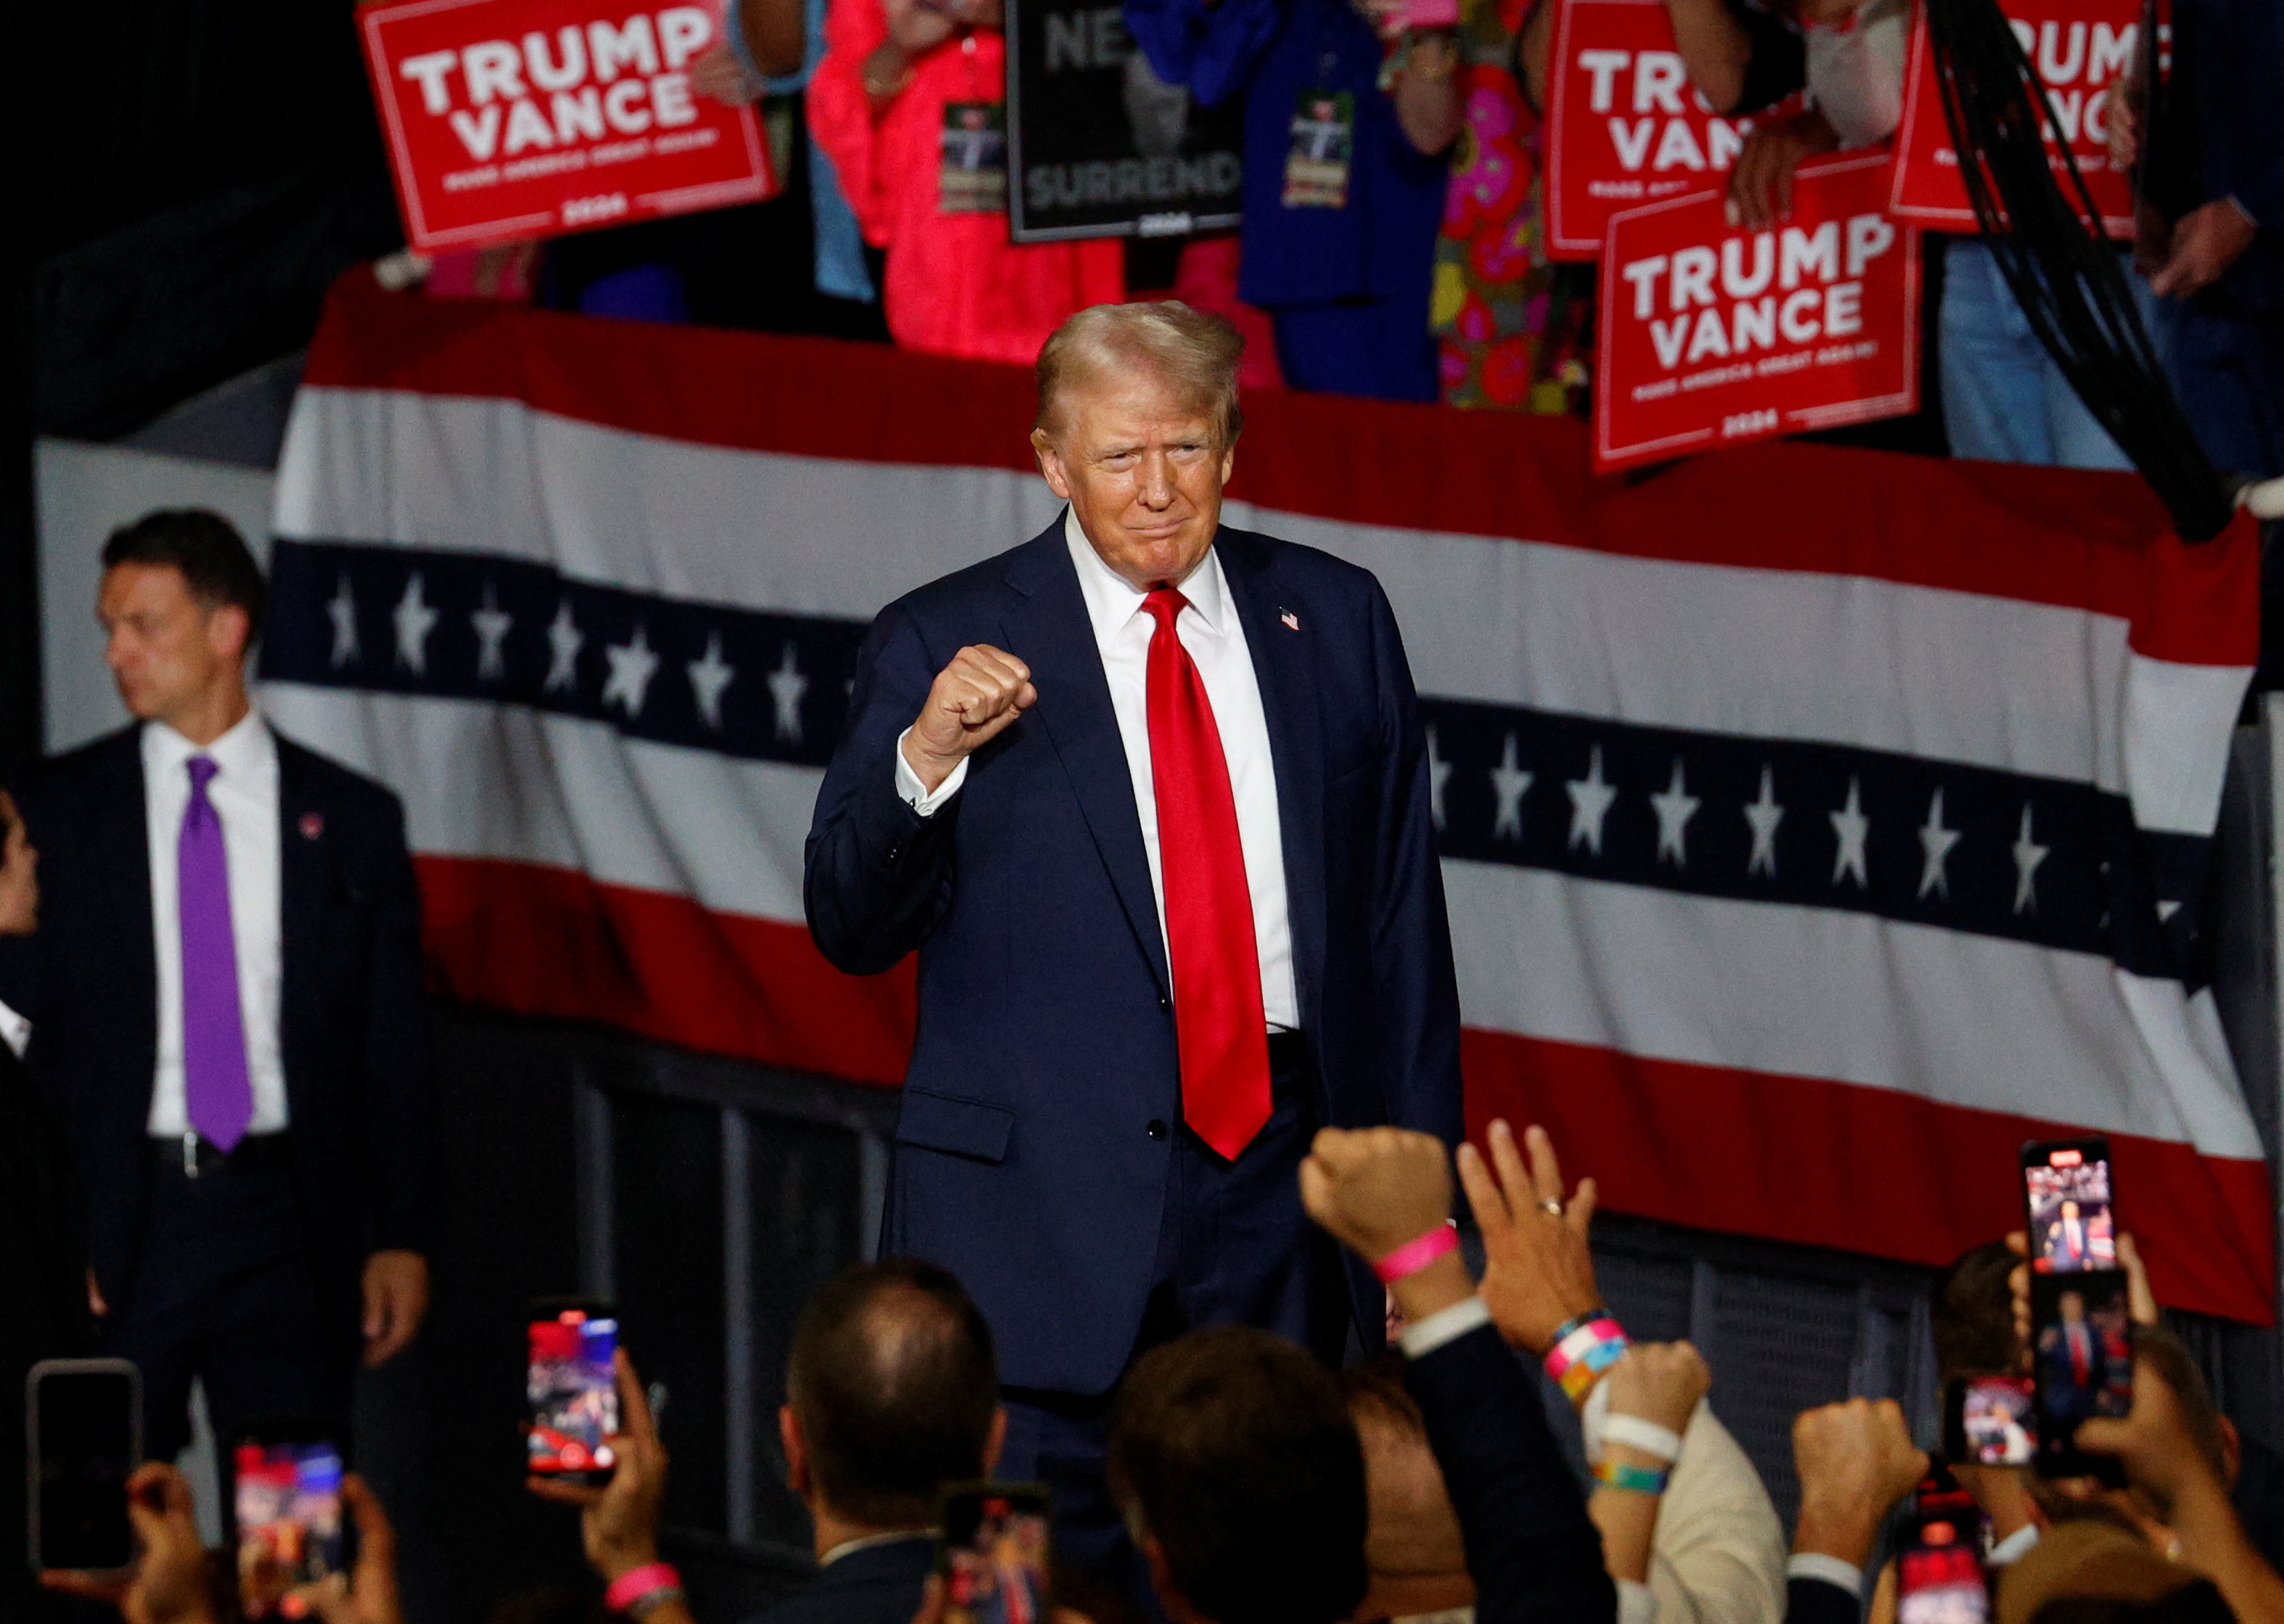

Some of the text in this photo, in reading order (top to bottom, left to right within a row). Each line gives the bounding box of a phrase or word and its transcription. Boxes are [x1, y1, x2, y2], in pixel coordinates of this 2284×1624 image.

[399, 7, 712, 115] TRUMP
[450, 73, 699, 161] VANCE
[1607, 117, 1756, 171] VAN
[1028, 150, 1242, 211] SURREND
[1623, 213, 1896, 321] TRUMP
[1649, 279, 1864, 371] VANCE
